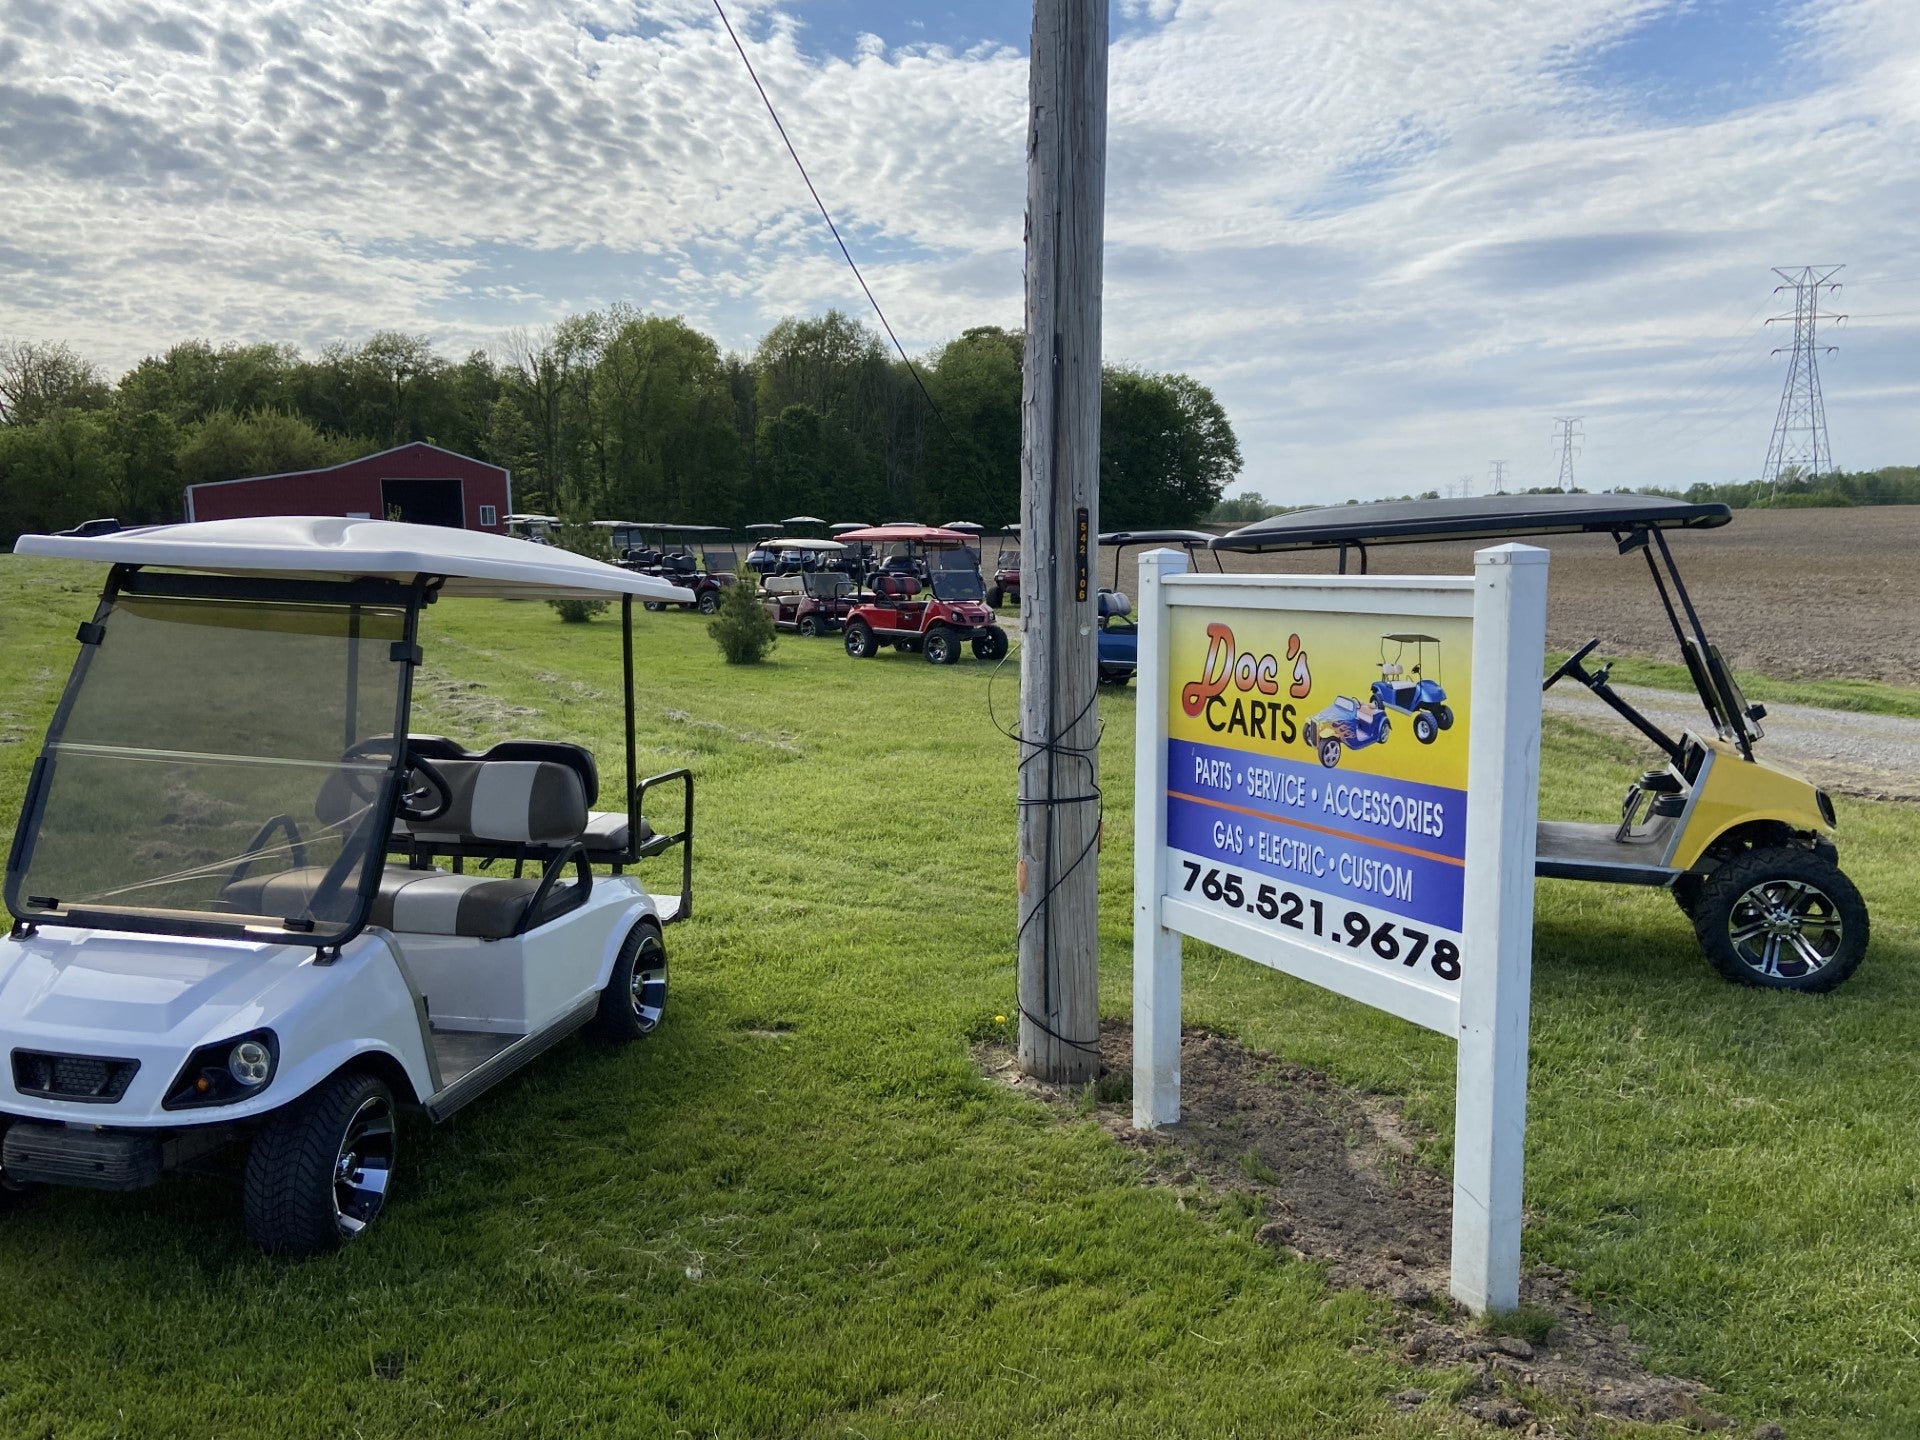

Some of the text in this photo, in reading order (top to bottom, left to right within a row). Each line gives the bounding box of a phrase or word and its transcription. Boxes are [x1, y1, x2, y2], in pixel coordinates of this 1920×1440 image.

[1182, 622, 1312, 718] Doc's
[1205, 696, 1297, 744] CARTS
[1194, 756, 1444, 839] PARTS SERVICE ACCESSORIES
[1213, 820, 1413, 902] GAS ELECTRIC CUSTOM
[1183, 860, 1462, 981] 765.521.9678
